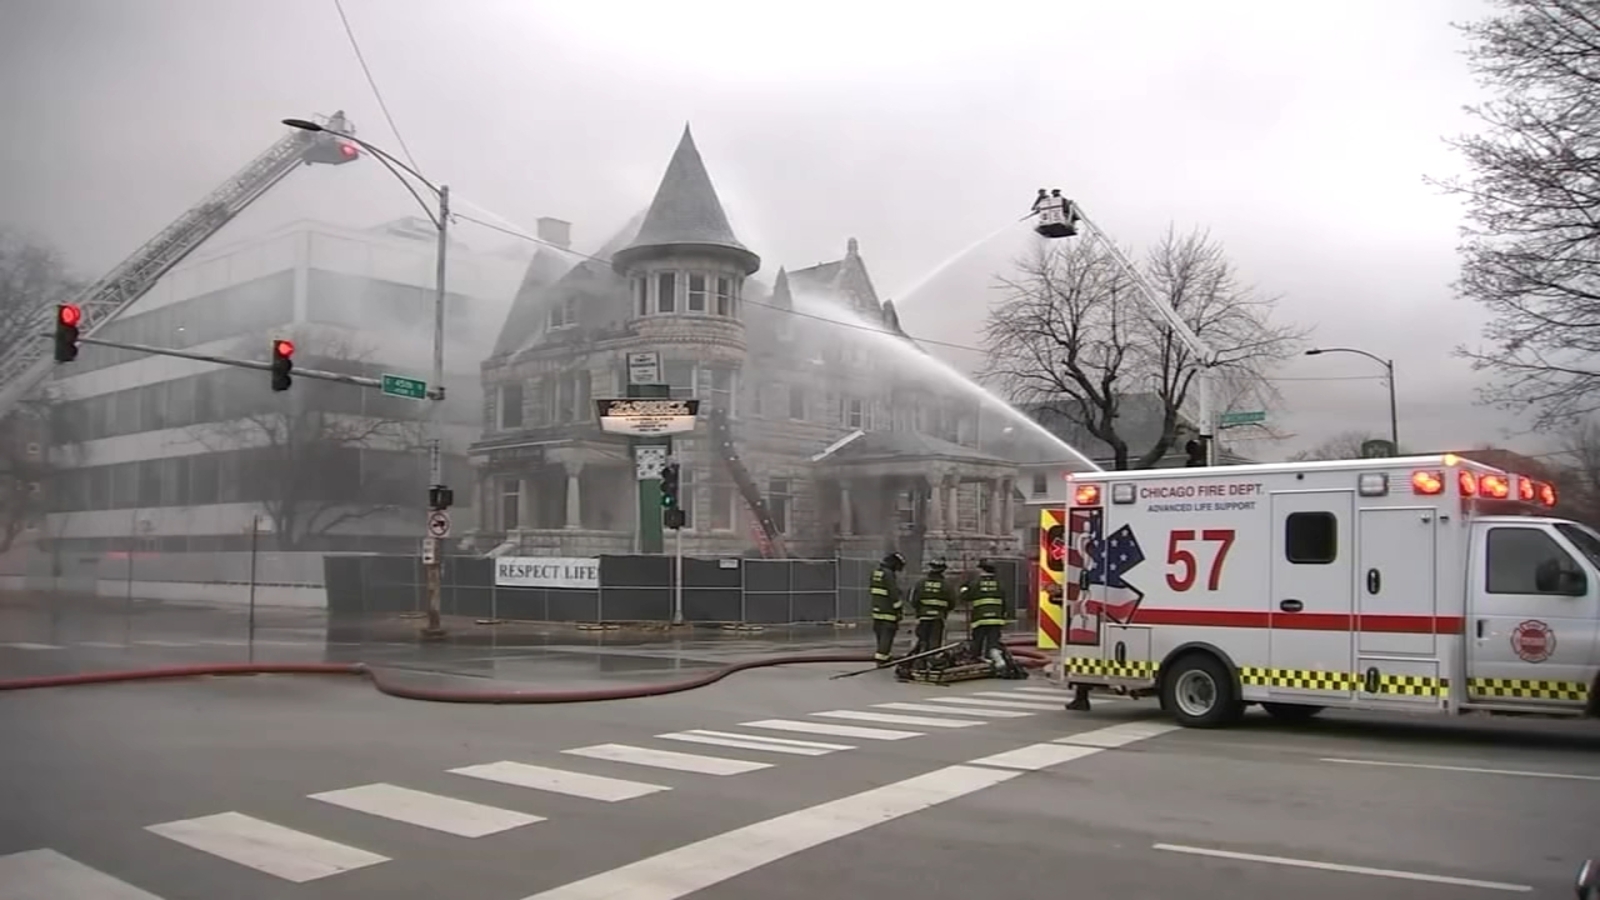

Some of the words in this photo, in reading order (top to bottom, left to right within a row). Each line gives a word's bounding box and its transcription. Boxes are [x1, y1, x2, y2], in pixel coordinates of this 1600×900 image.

[1140, 486, 1195, 499] CHICAGO
[1198, 485, 1226, 496] FIRE
[1228, 483, 1265, 496] DEPT.
[1147, 503, 1192, 513] ADVANCED
[1194, 502, 1212, 512] LIFE
[1214, 501, 1256, 511] SUPPORT
[1165, 529, 1236, 592] 57
[499, 564, 561, 579] RESPECT
[564, 565, 597, 580] LIFE
